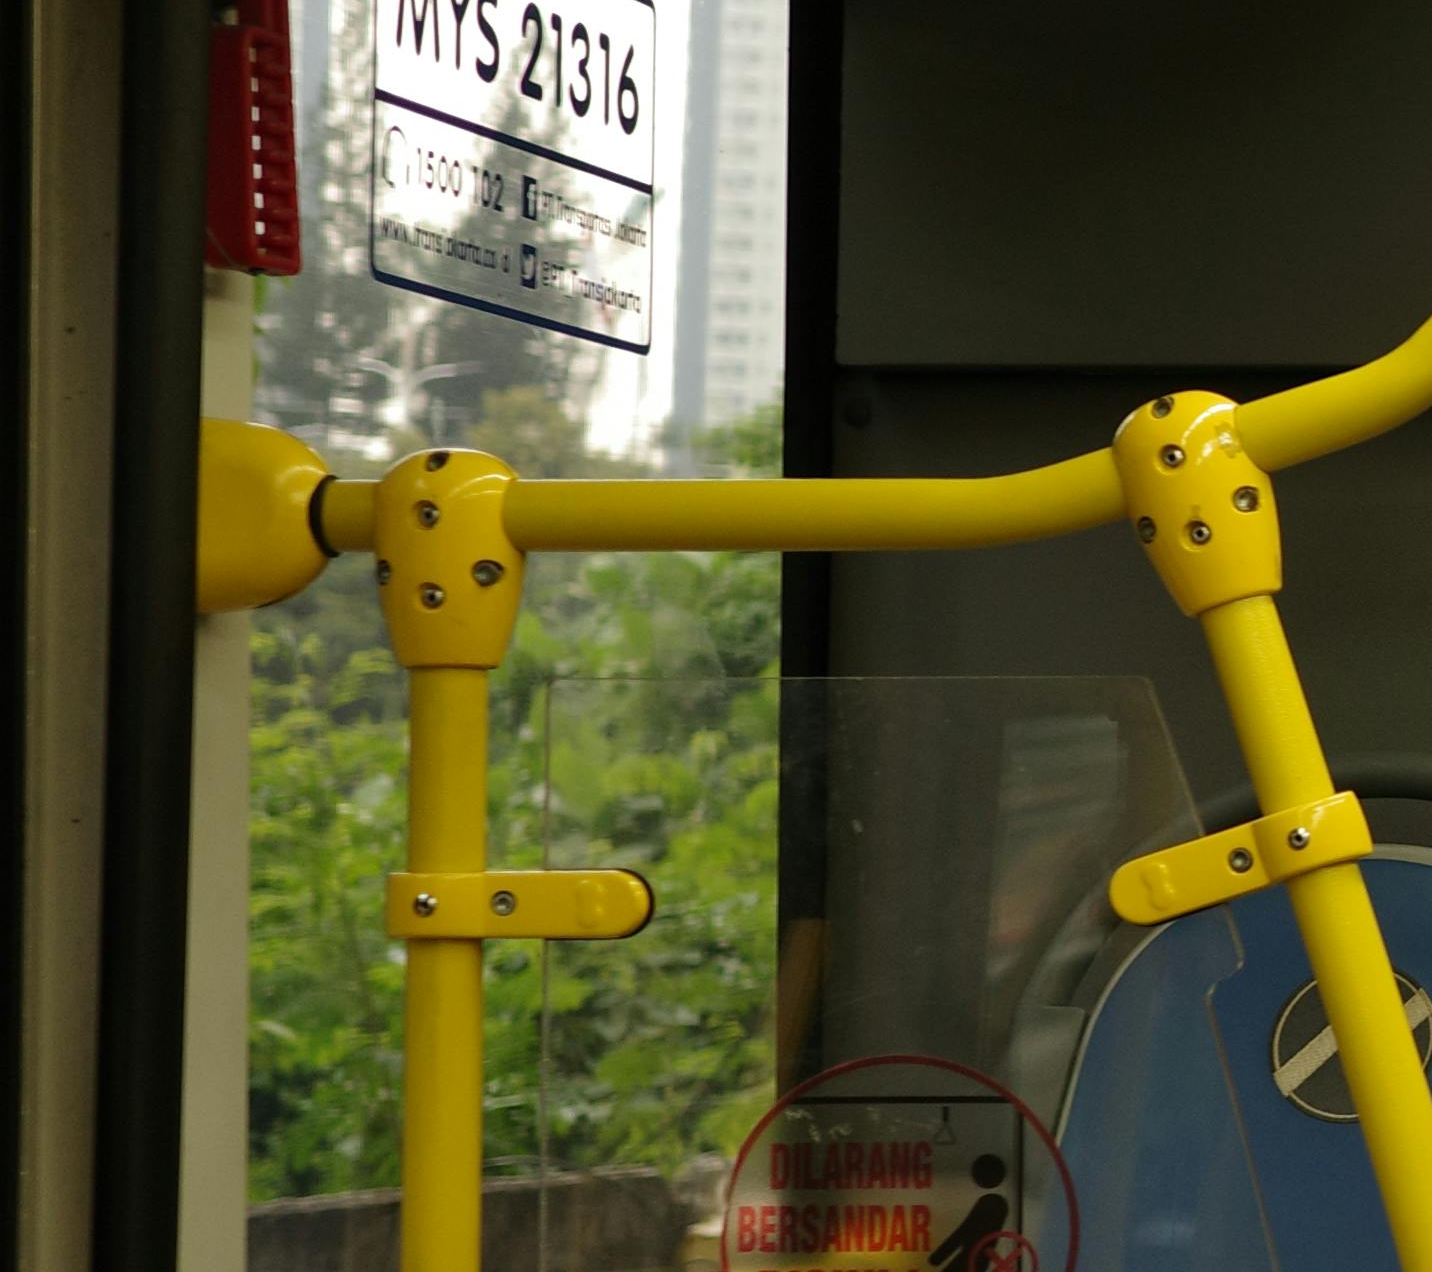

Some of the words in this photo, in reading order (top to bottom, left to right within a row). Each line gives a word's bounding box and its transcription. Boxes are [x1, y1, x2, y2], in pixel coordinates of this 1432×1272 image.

[520, 2, 639, 135] 21316
[768, 1141, 934, 1190] DILARANG
[737, 1204, 933, 1253] BERSANDAR
